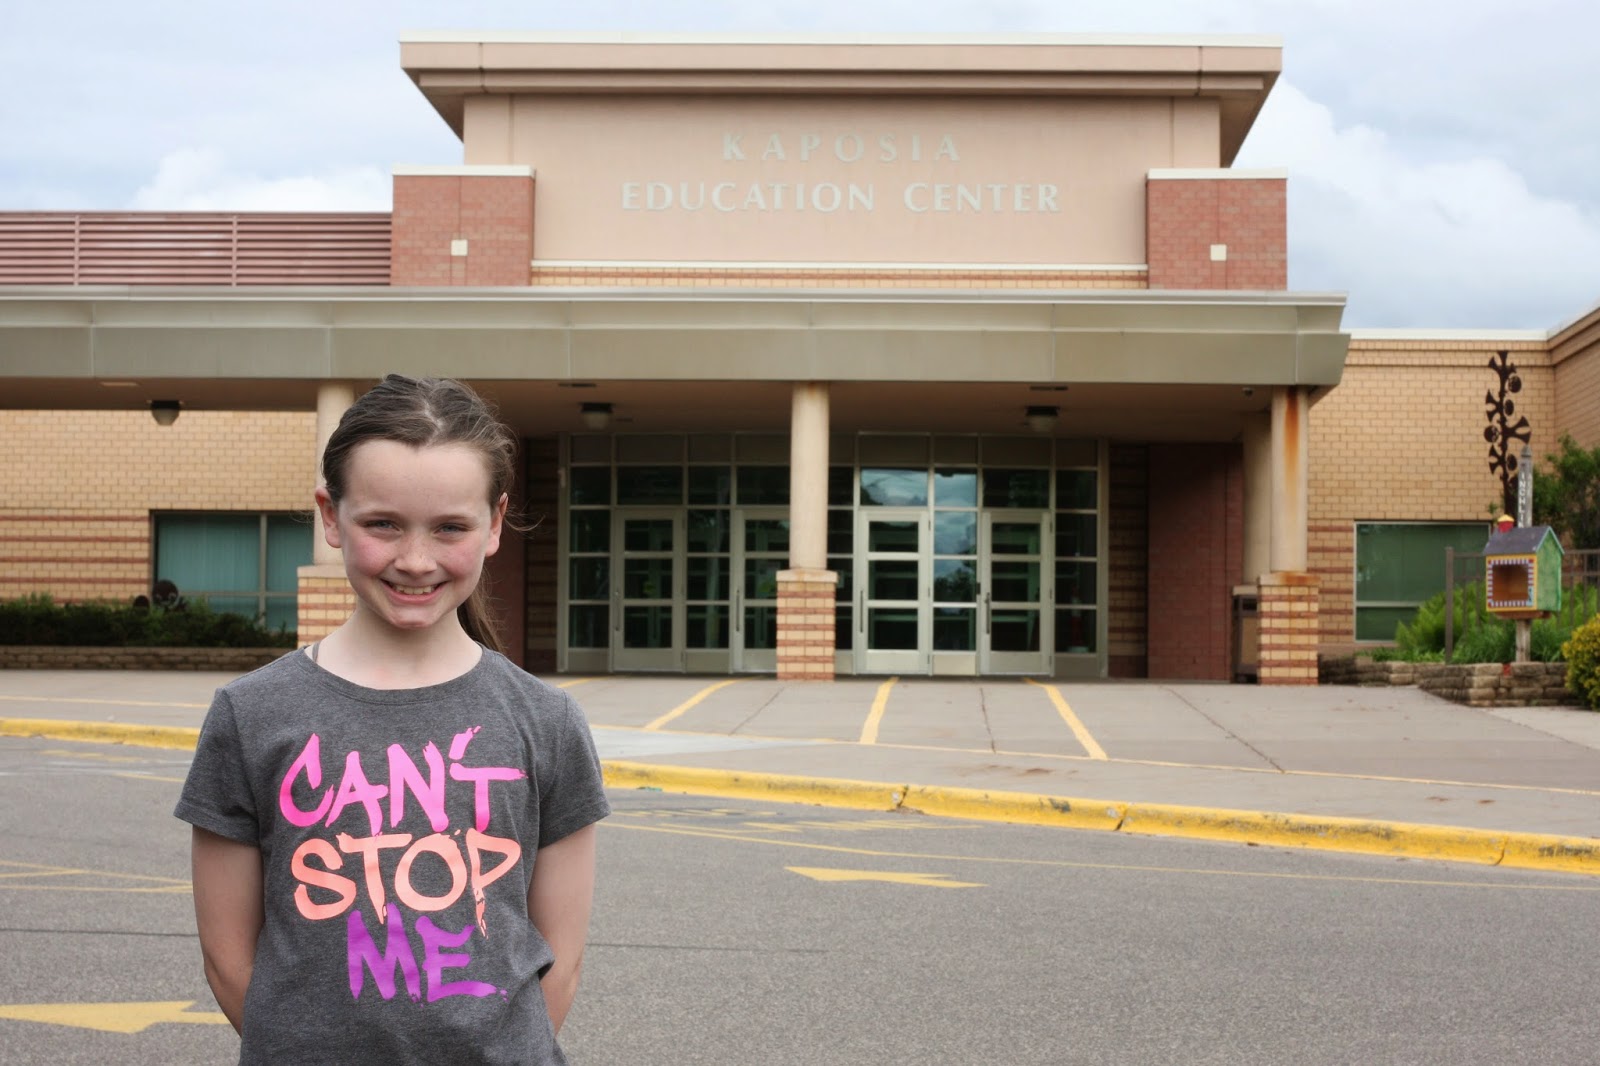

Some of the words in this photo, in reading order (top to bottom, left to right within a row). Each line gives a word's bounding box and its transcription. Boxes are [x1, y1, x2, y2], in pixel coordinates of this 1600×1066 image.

[621, 181, 874, 213] EDUCATION
[903, 182, 1060, 213] CENTER
[722, 132, 960, 162] KAPOSIA
[279, 725, 528, 836] CAN'T
[291, 828, 522, 939] STOP
[347, 903, 508, 1003] ME
